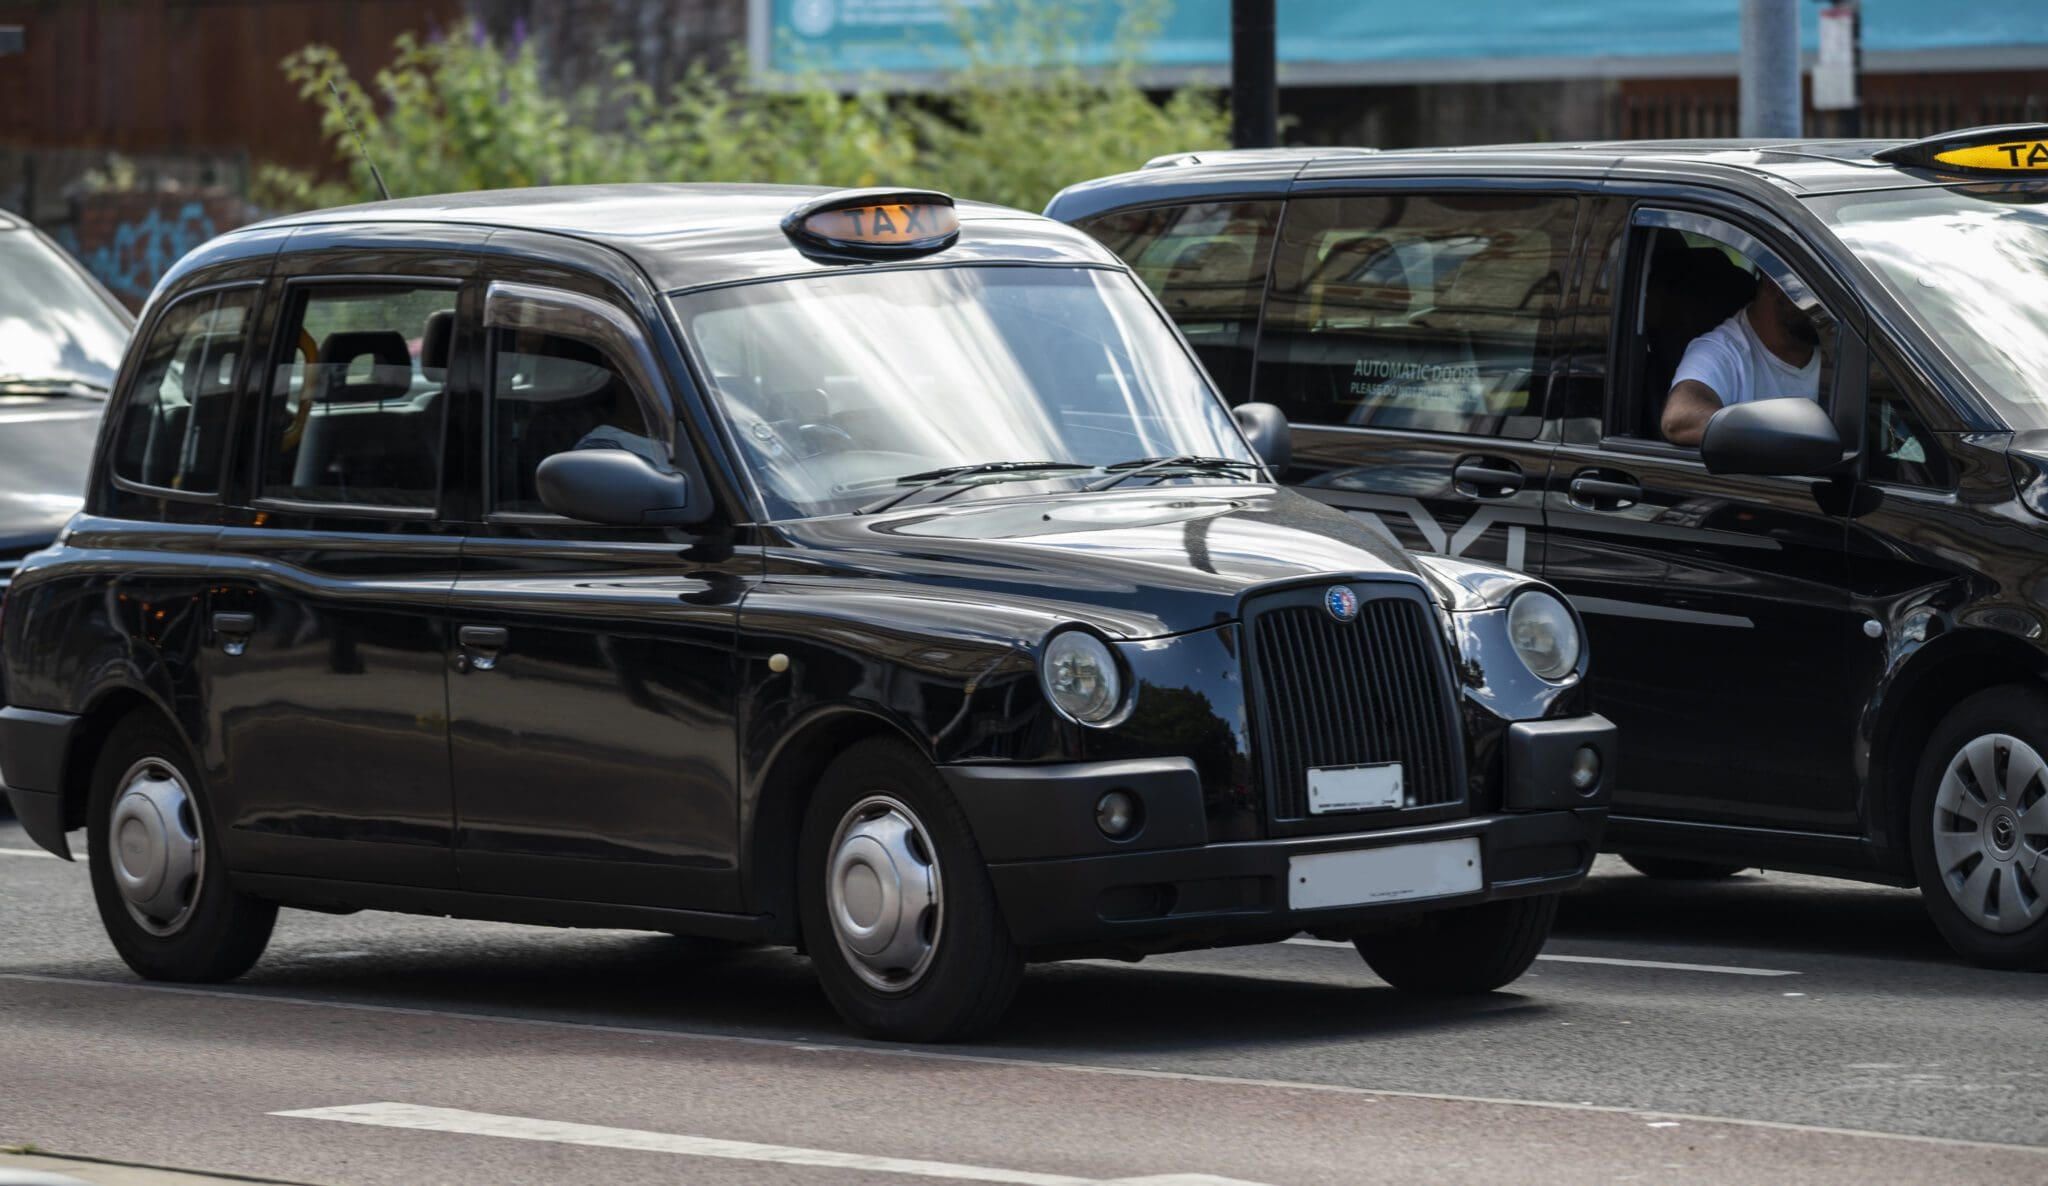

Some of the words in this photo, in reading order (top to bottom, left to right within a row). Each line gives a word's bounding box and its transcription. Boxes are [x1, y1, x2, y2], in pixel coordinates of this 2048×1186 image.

[842, 205, 941, 237] TAXI
[1353, 359, 1430, 381] AUTOMATIC
[1350, 382, 1383, 395] PLEASE
[1384, 384, 1397, 396] DO
